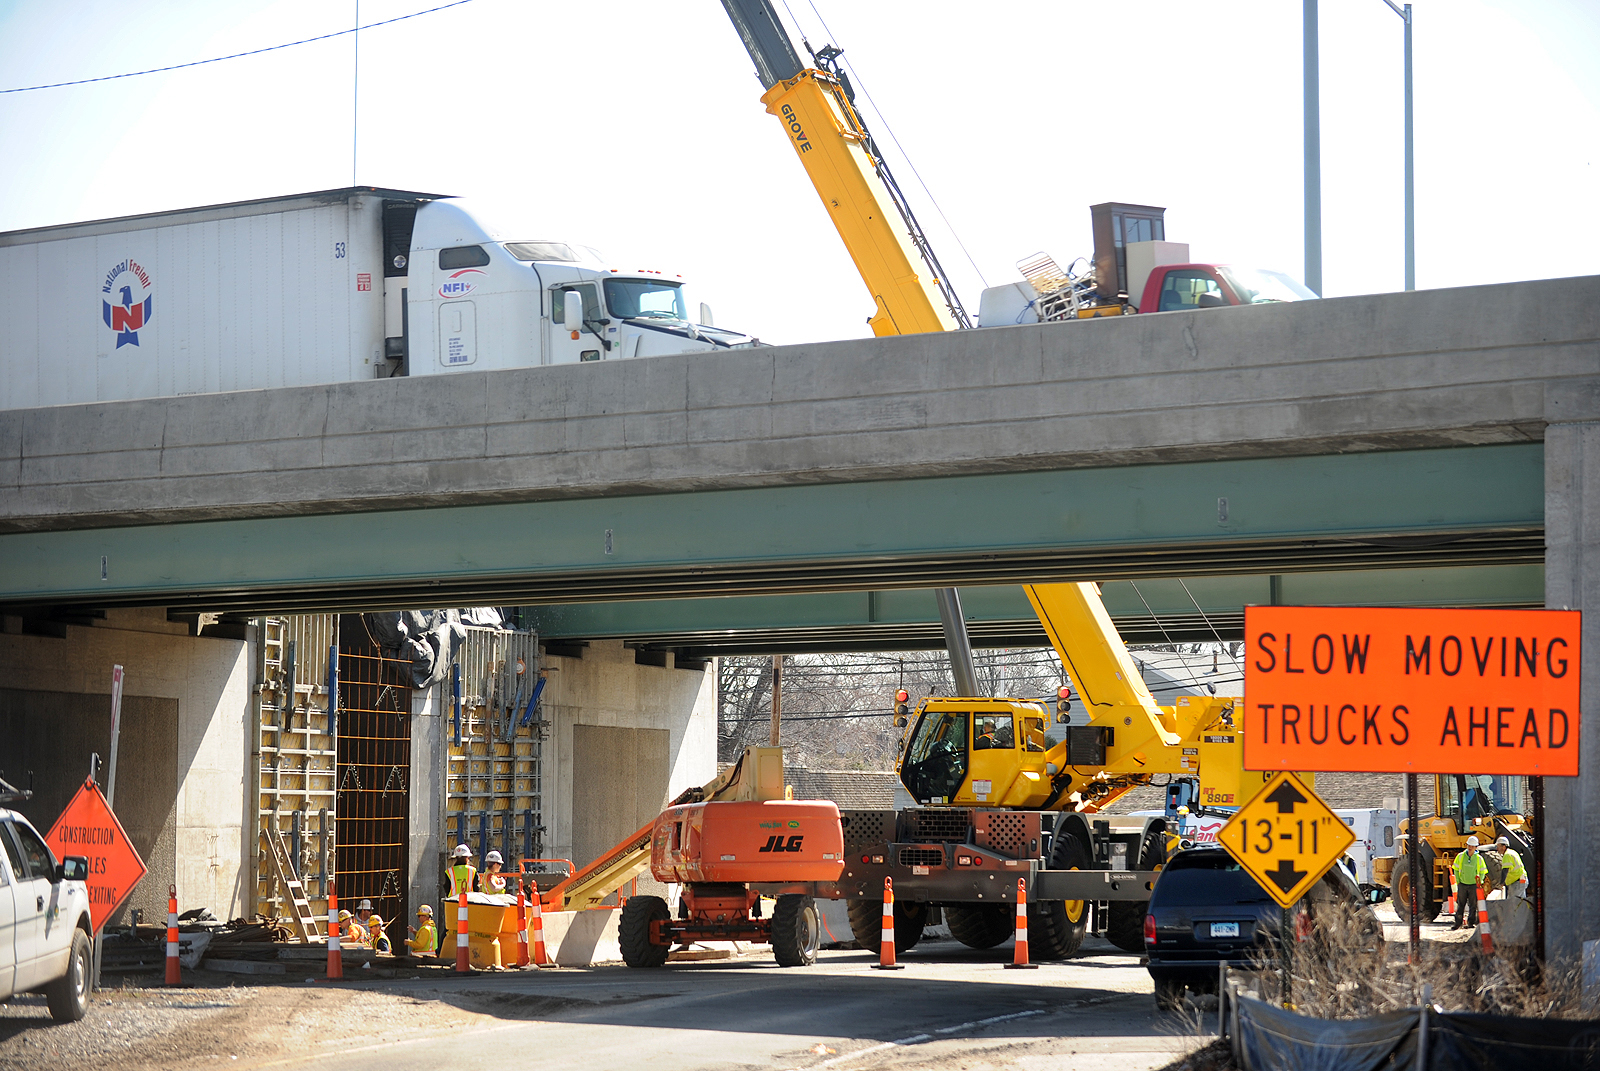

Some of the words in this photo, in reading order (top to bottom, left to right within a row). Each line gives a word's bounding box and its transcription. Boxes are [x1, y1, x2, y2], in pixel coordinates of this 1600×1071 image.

[781, 104, 812, 153] GROVE
[335, 242, 346, 259] 53
[102, 259, 128, 293] National
[129, 259, 151, 290] Freight
[443, 282, 465, 293] NFI
[112, 302, 143, 331] N
[1255, 632, 1371, 675] SLOW
[1404, 635, 1569, 679] MOVING
[1257, 703, 1410, 746] TRUCKS
[1439, 706, 1569, 750] AHEAD
[1203, 787, 1216, 795] RT
[1206, 793, 1235, 803] 880E
[59, 825, 115, 846] CONSTRUCTION
[759, 836, 804, 852] JLG
[1239, 816, 1332, 855] 13'-11"
[89, 886, 117, 906] EXITING
